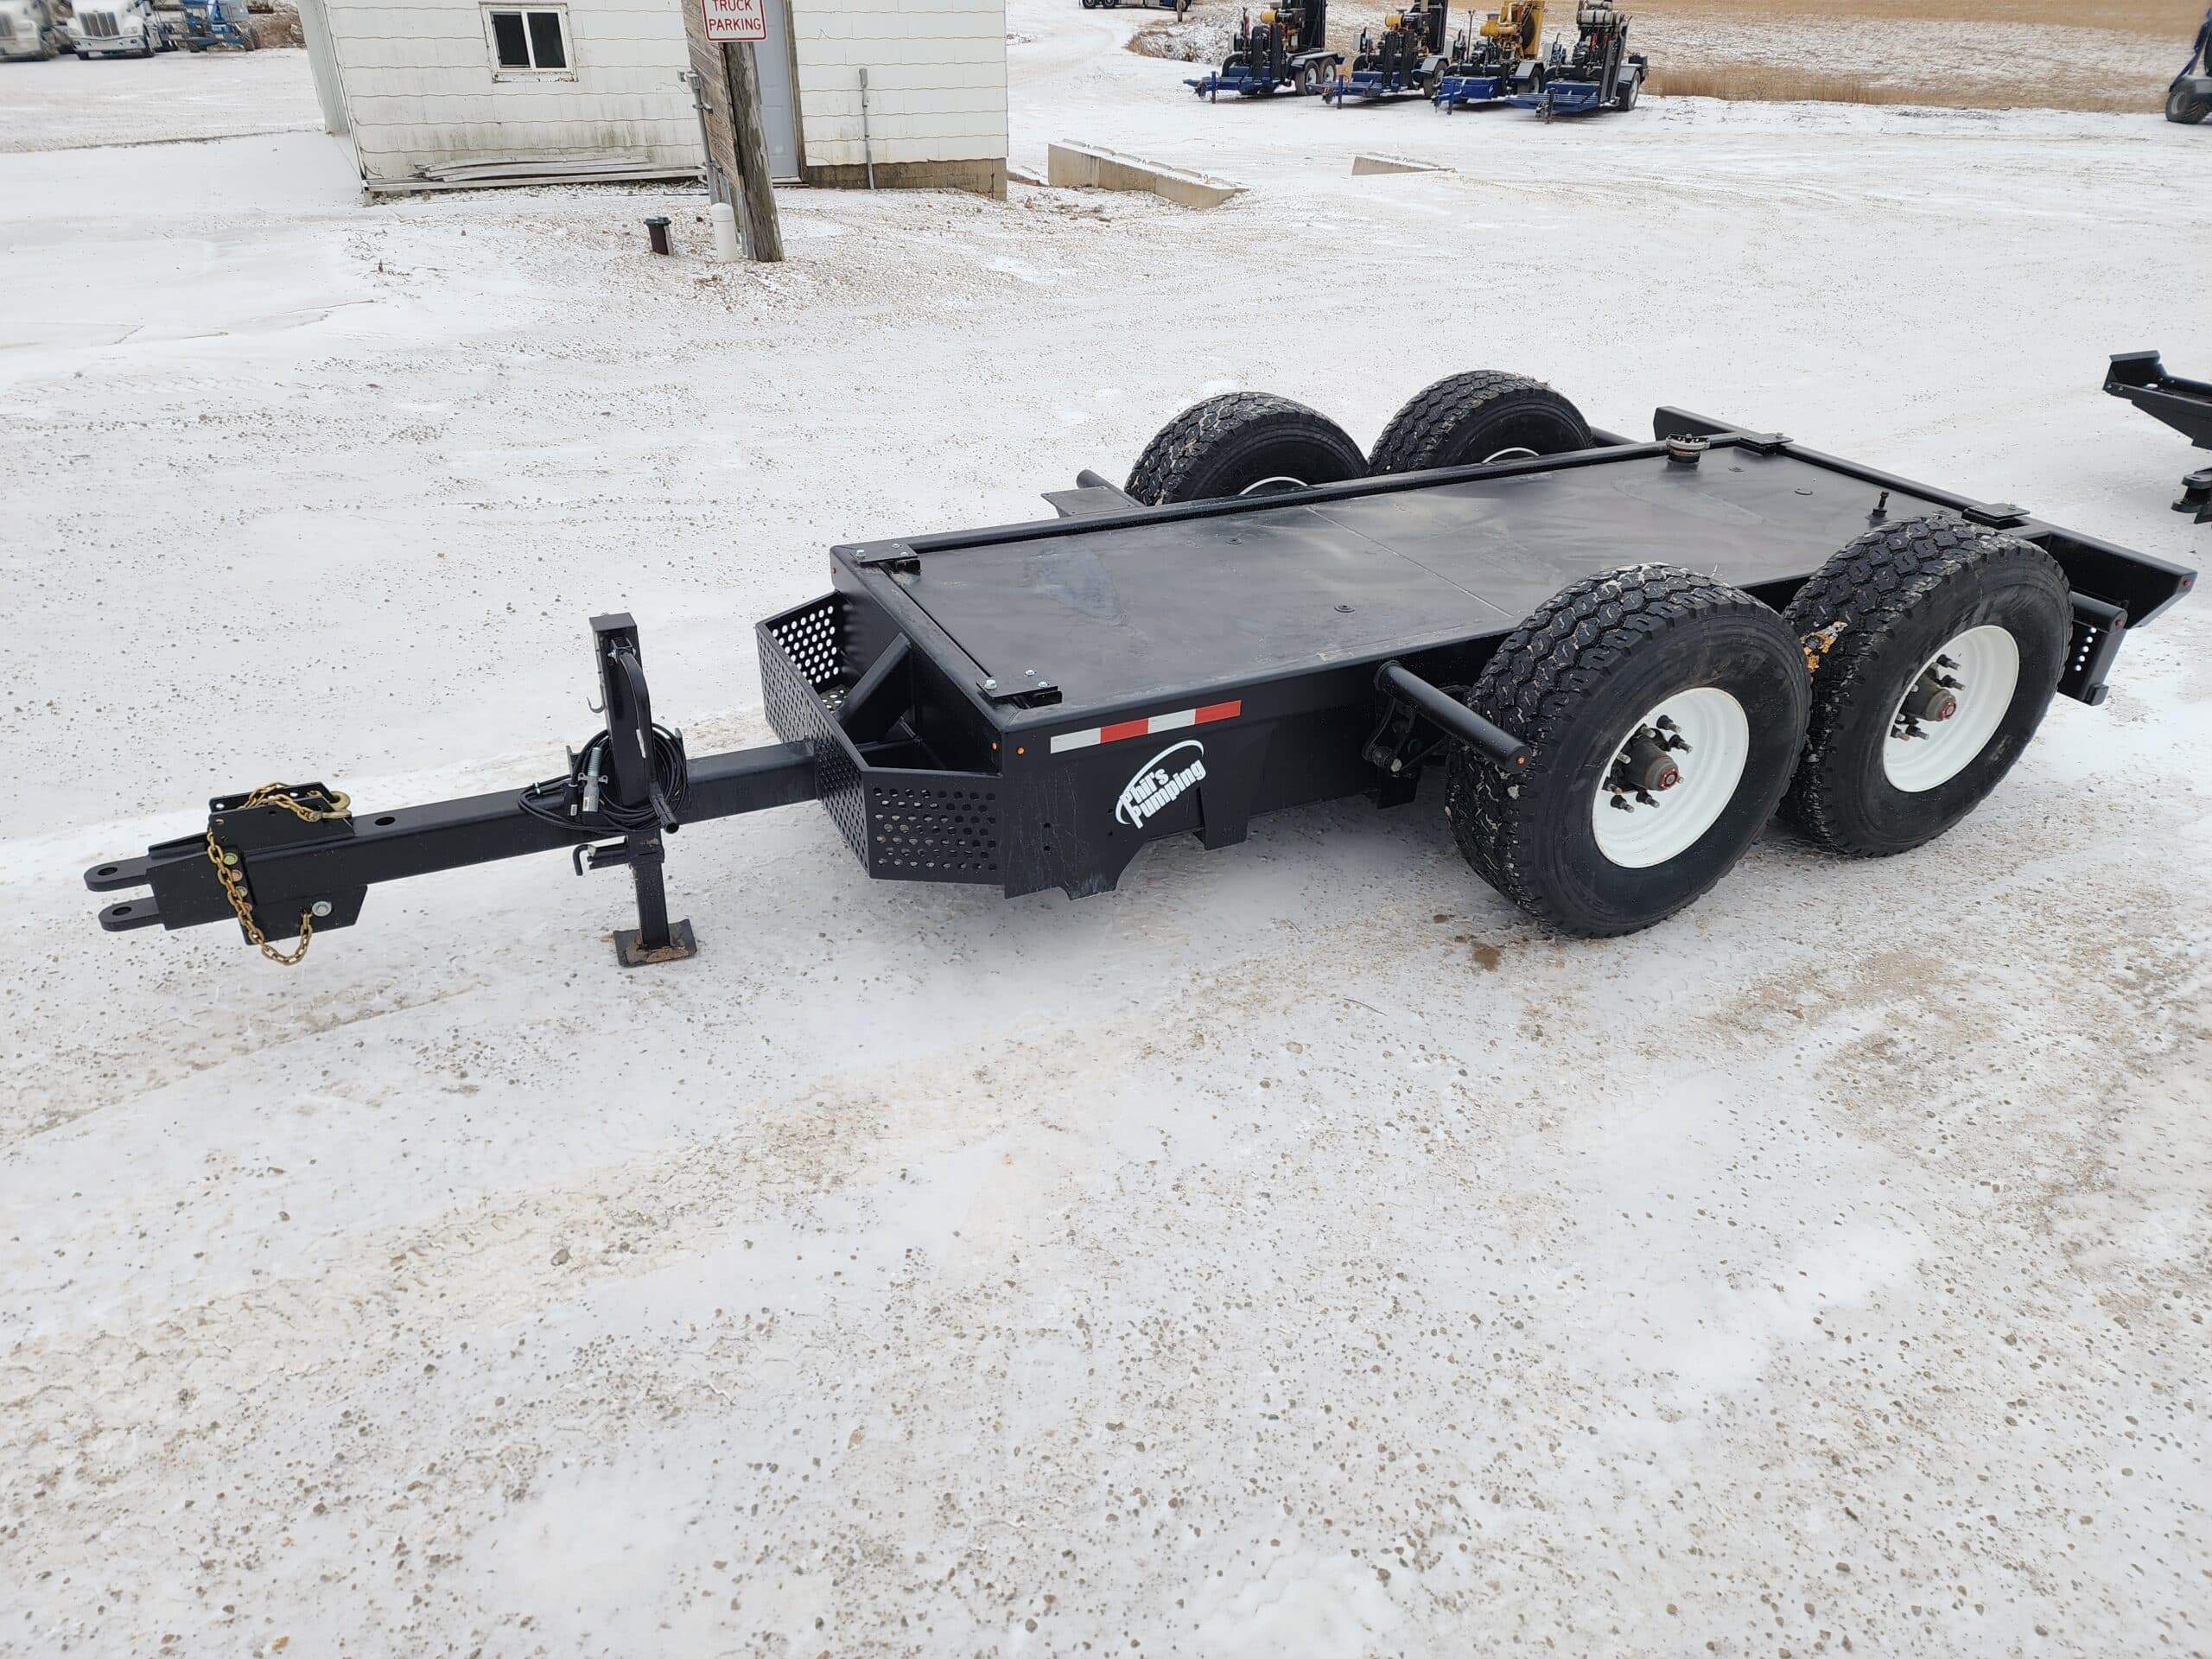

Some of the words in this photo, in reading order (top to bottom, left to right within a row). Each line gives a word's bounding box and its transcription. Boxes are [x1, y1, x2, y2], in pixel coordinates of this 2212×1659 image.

[711, 0, 753, 11] TRUCK
[709, 18, 761, 31] PARKING
[1119, 768, 1169, 804] Phil's
[1126, 760, 1206, 829] Pumping
